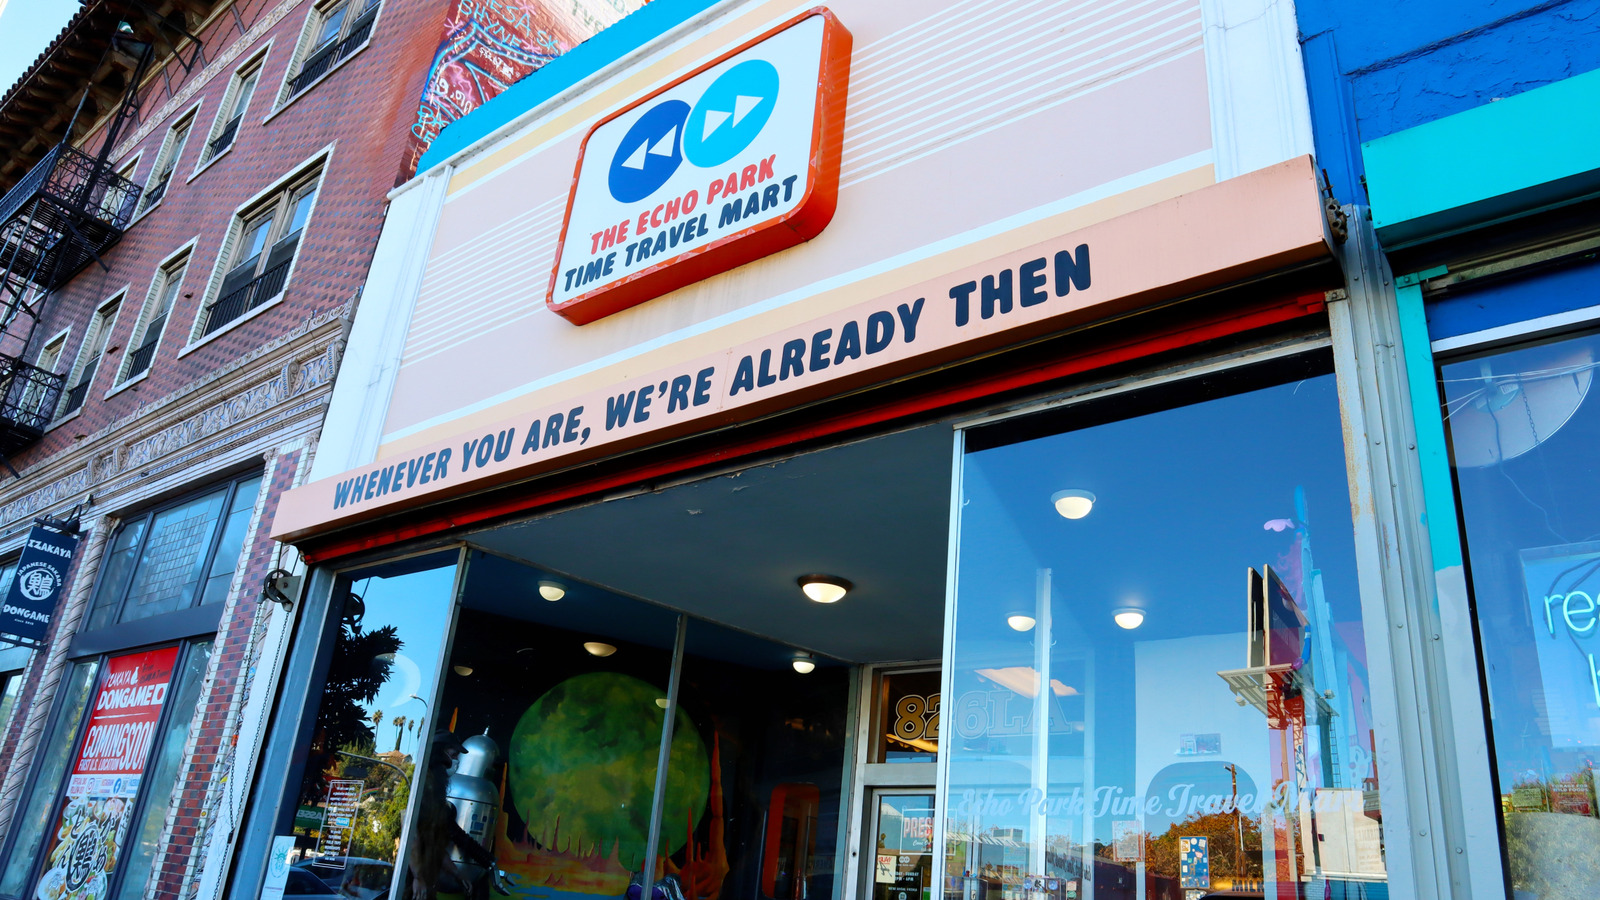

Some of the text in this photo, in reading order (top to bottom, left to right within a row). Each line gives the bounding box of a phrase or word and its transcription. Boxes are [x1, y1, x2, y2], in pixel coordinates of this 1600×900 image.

[590, 153, 776, 255] THE ECHO PARK
[564, 174, 798, 292] TIME TRAVEL MART
[333, 243, 1093, 511] WHENEVER YOU ARE, WE'RE ALREADY THEN
[17, 561, 47, 577] JAPANESE
[28, 539, 72, 558] IZAKAYA
[3, 604, 51, 624] DONGAME
[97, 685, 153, 710] DONGAME
[894, 686, 1072, 740] 826LA
[83, 721, 154, 771] COMING SOON
[957, 788, 1015, 817] Echo
[1018, 787, 1087, 817] Park
[1088, 785, 1163, 818] Time
[1165, 783, 1268, 818] Travel
